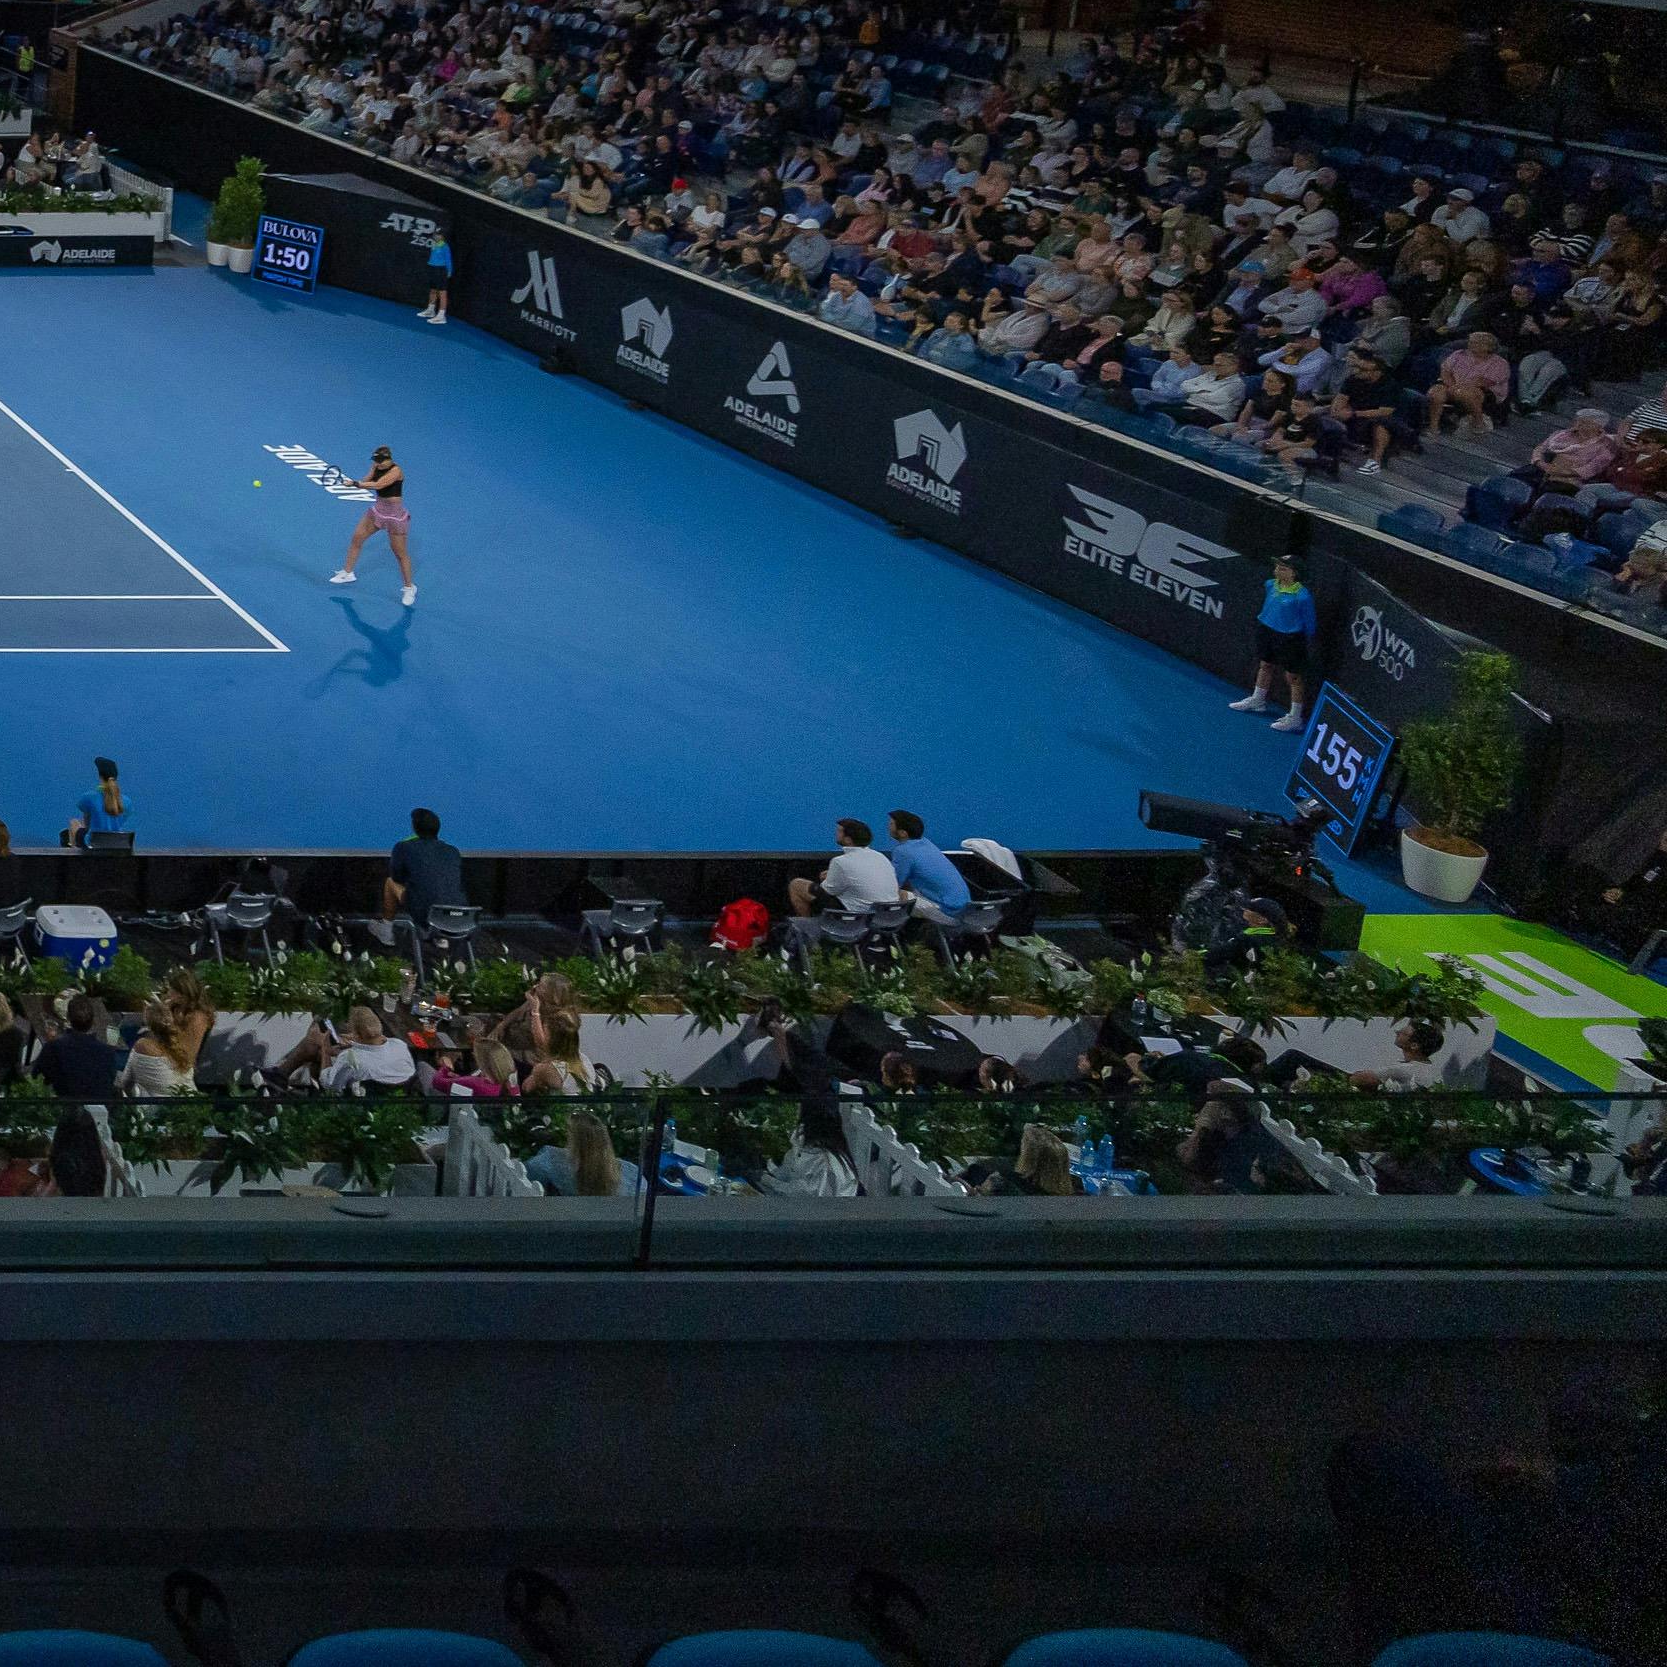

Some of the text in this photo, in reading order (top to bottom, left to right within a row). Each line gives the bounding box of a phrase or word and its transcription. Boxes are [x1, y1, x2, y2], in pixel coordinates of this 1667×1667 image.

[263, 221, 317, 243] BULOVA
[379, 212, 442, 234] ATP
[62, 249, 116, 259] ADELAIDE
[263, 243, 310, 271] 1:50
[410, 235, 434, 249] 250
[520, 308, 577, 342] MARRIOTT
[617, 344, 670, 378] ADELAIDE
[723, 395, 798, 438] ADELAIDE
[262, 444, 377, 502] ADELAIDE
[886, 462, 962, 509] ADELAIDE
[1063, 534, 1224, 620] ELITE ELEVEN
[1378, 649, 1404, 681] 500
[1386, 627, 1415, 669] WTA
[1306, 722, 1363, 791] 155
